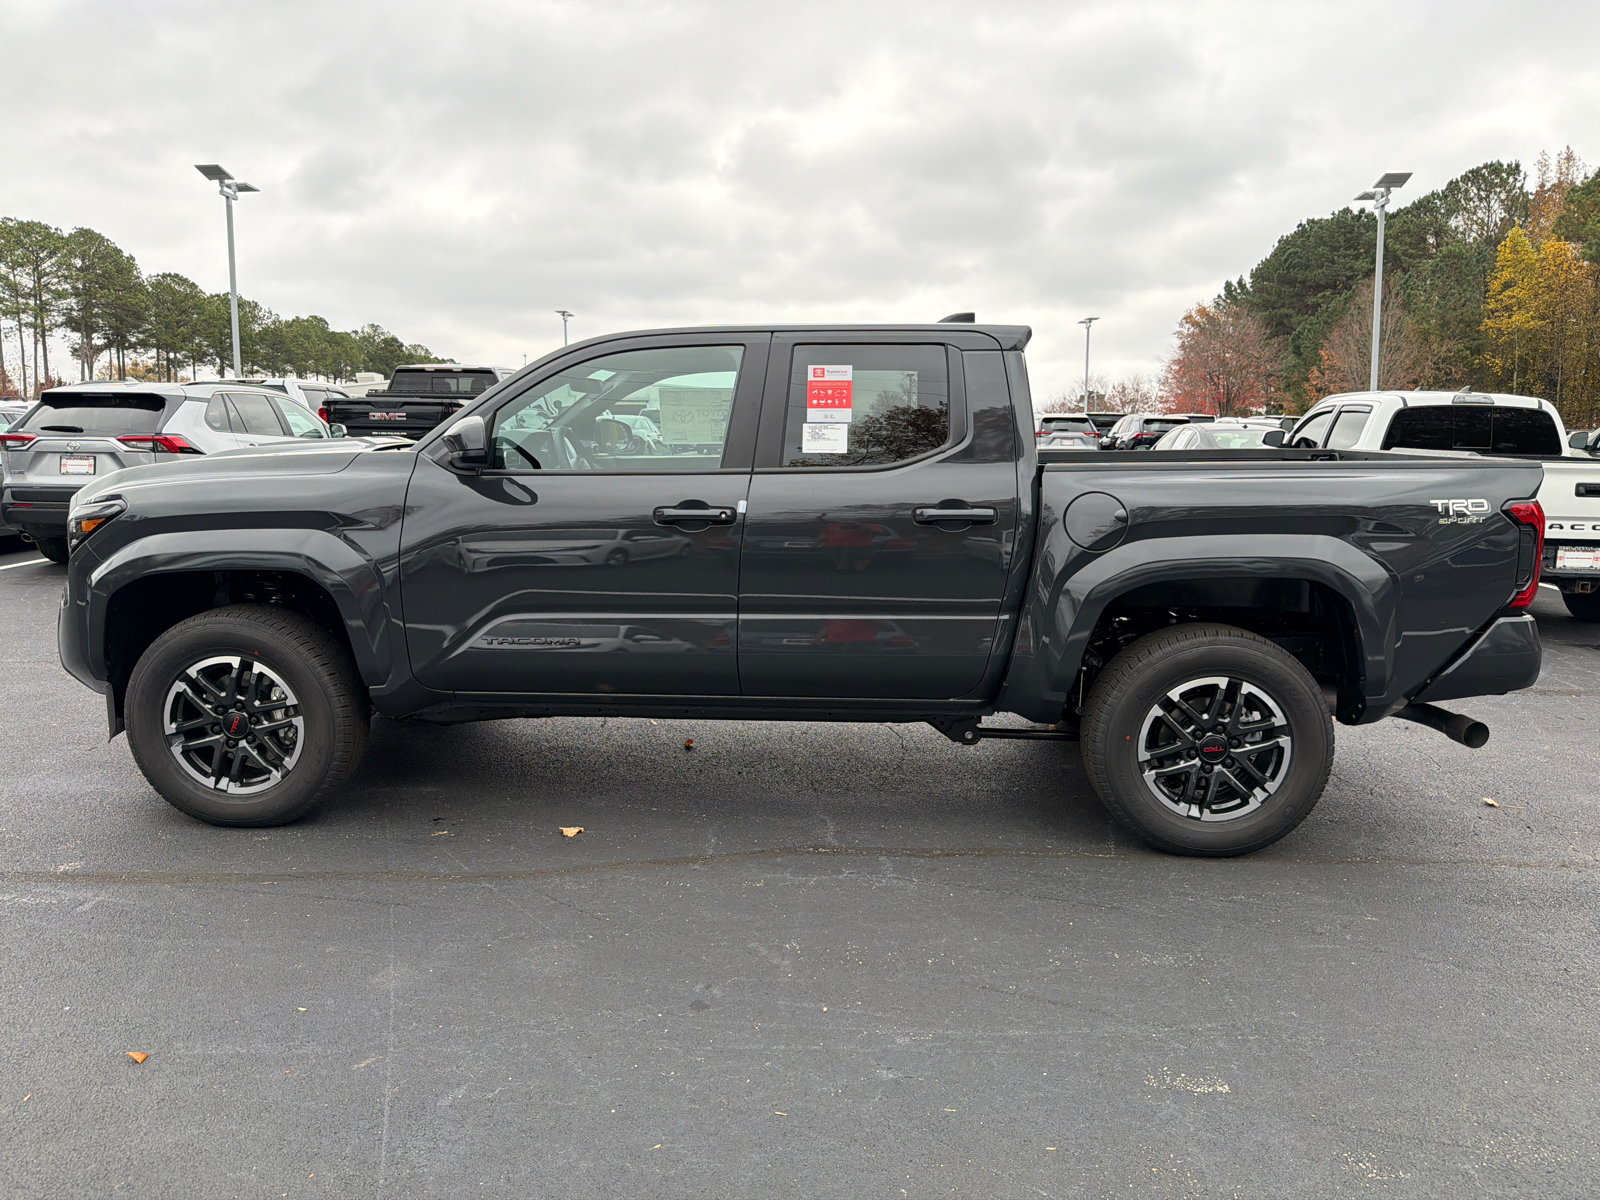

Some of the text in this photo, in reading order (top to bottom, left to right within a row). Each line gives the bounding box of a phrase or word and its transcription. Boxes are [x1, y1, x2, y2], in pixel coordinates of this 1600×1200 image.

[369, 412, 407, 421] GMC
[1429, 499, 1489, 516] TRD
[1438, 517, 1486, 525] SPORT
[481, 636, 581, 646] TACOMA
[230, 715, 241, 734] TRD
